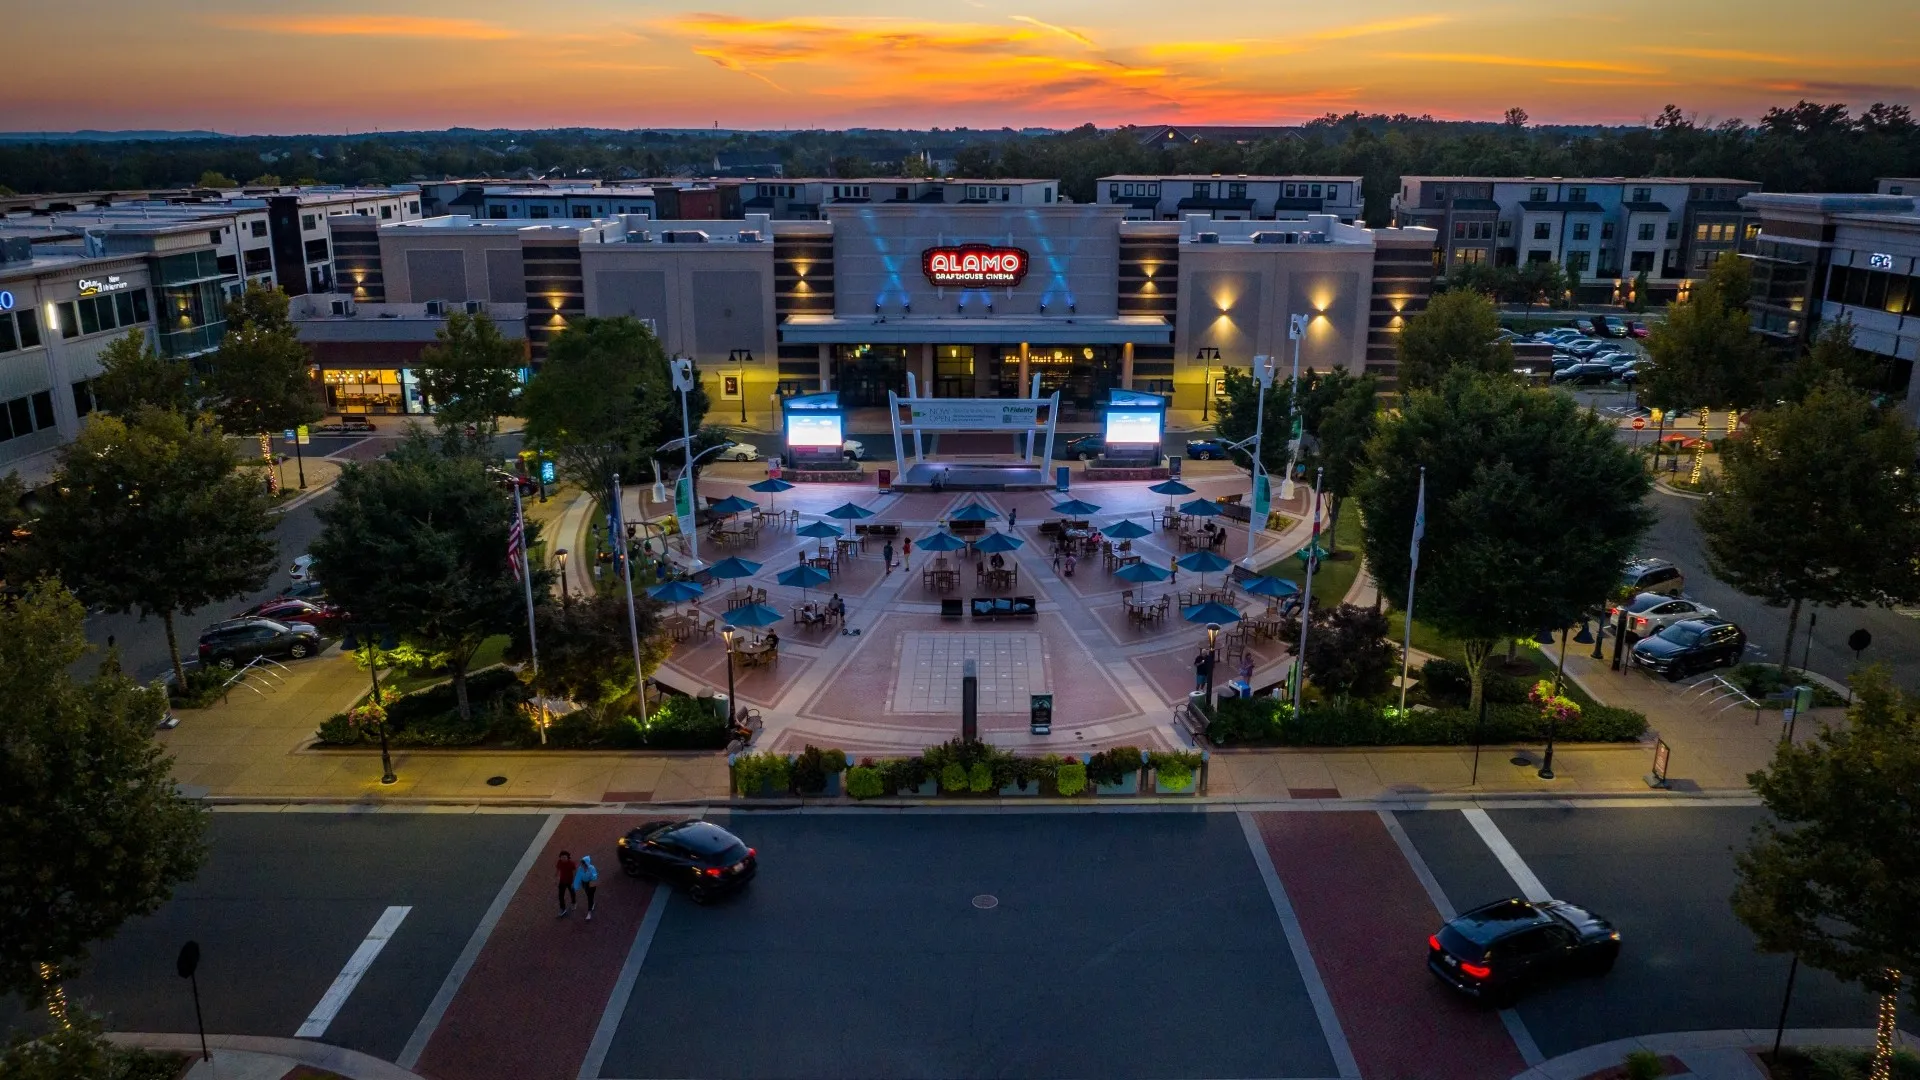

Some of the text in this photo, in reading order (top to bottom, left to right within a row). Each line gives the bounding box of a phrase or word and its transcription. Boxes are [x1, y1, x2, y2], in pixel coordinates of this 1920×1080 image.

[931, 254, 1019, 272] ALAMO
[929, 407, 949, 415] NOW
[1010, 405, 1035, 414] Fidelity
